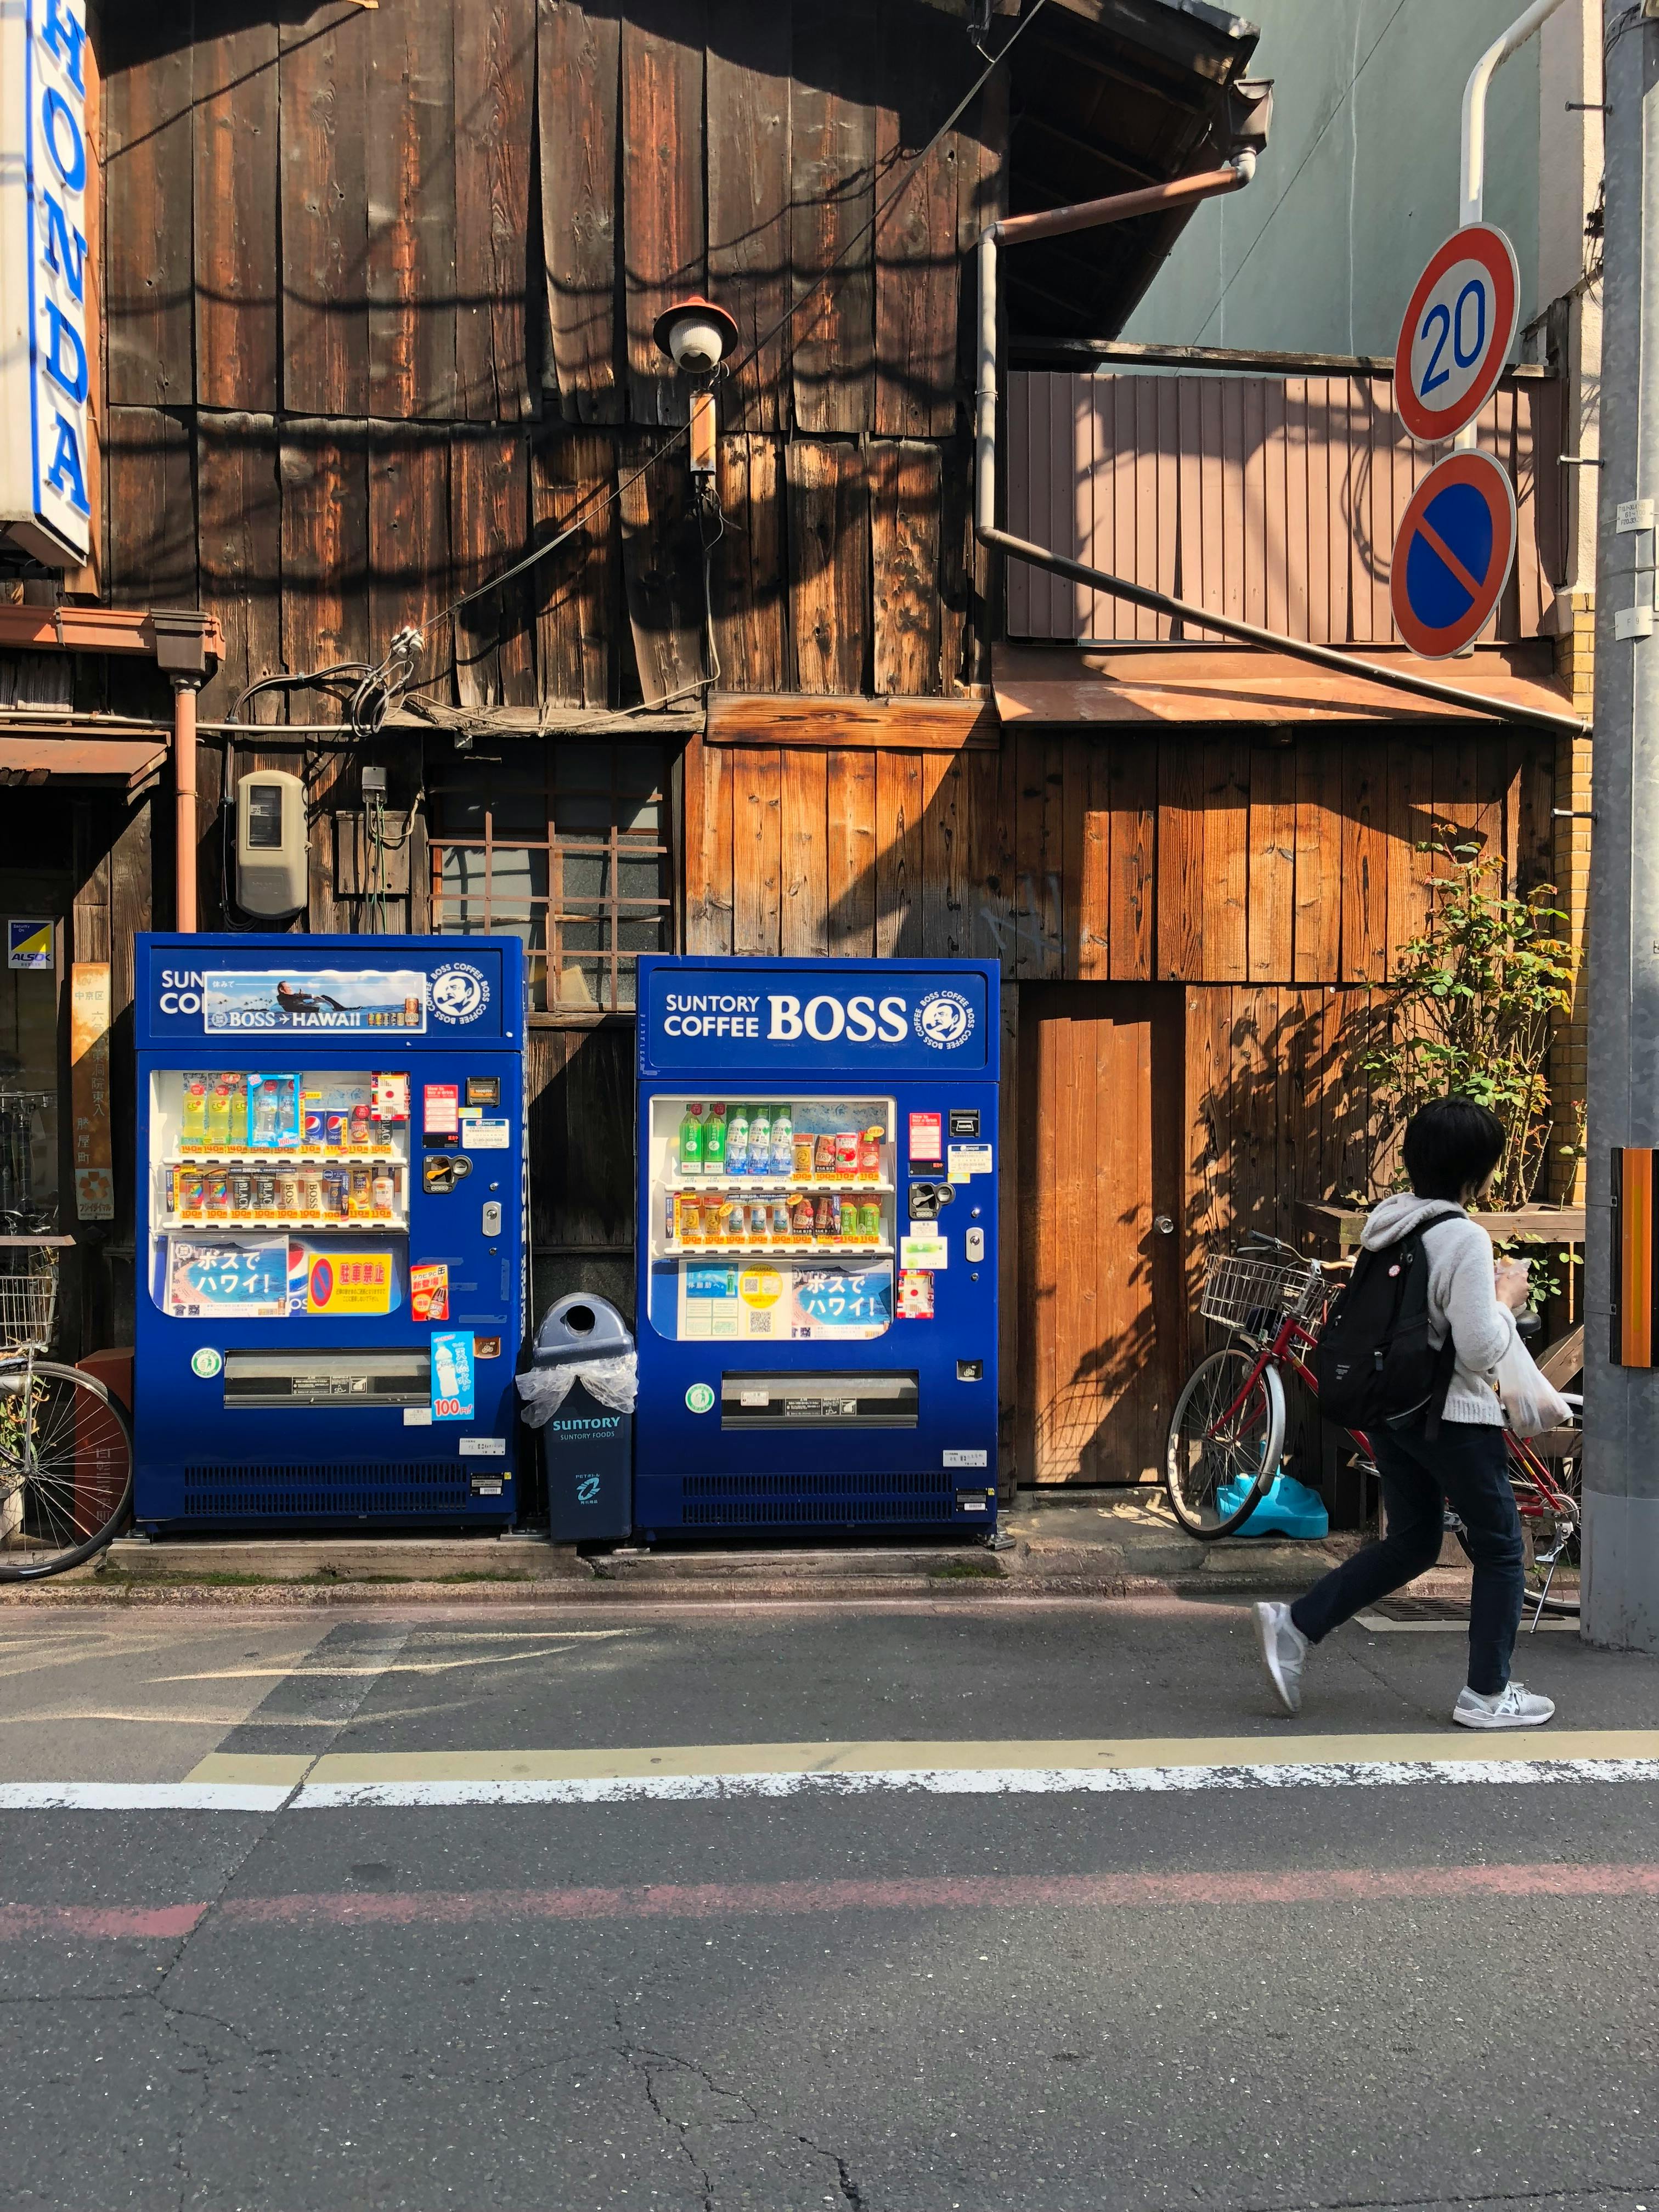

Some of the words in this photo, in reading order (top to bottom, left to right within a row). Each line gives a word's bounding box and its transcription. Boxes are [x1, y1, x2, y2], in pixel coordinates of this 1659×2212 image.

[42, 0, 90, 517] HONDA
[1420, 279, 1485, 397] 20
[1627, 618, 1630, 627] F
[162, 970, 204, 988] SUN
[430, 964, 451, 979] BOSS
[454, 962, 484, 980] COFFEE
[75, 991, 104, 1001] 中京区
[426, 981, 435, 1012] COFFEE
[481, 981, 489, 1002] BOSS
[920, 991, 939, 1006] BOSS
[941, 990, 969, 1007] COFFEE
[666, 994, 760, 1012] SUNTORY
[229, 1012, 275, 1026] BOSS
[292, 1013, 360, 1026] HAWAII
[435, 1011, 455, 1025] BOSS
[459, 1004, 486, 1025] COFFEE
[767, 995, 908, 1042] BOSS
[913, 1008, 924, 1037] COFFEE
[966, 1008, 975, 1029] BOSS
[664, 1015, 759, 1037] COFFEE
[923, 1036, 943, 1049] BOSS
[946, 1030, 972, 1049] COFFEE
[239, 1183, 247, 1209] BLACK
[263, 1183, 272, 1204] BLAC
[286, 1184, 294, 1204] BOS
[309, 1184, 318, 1209] BOSS
[198, 1250, 260, 1271] ボスで
[340, 1262, 385, 1285] 駐車禁止
[807, 1273, 865, 1294] ボスで
[195, 1274, 269, 1294] ハワイ!
[806, 1297, 874, 1316] ハワイ!
[553, 1417, 621, 1431] SUNTORY
